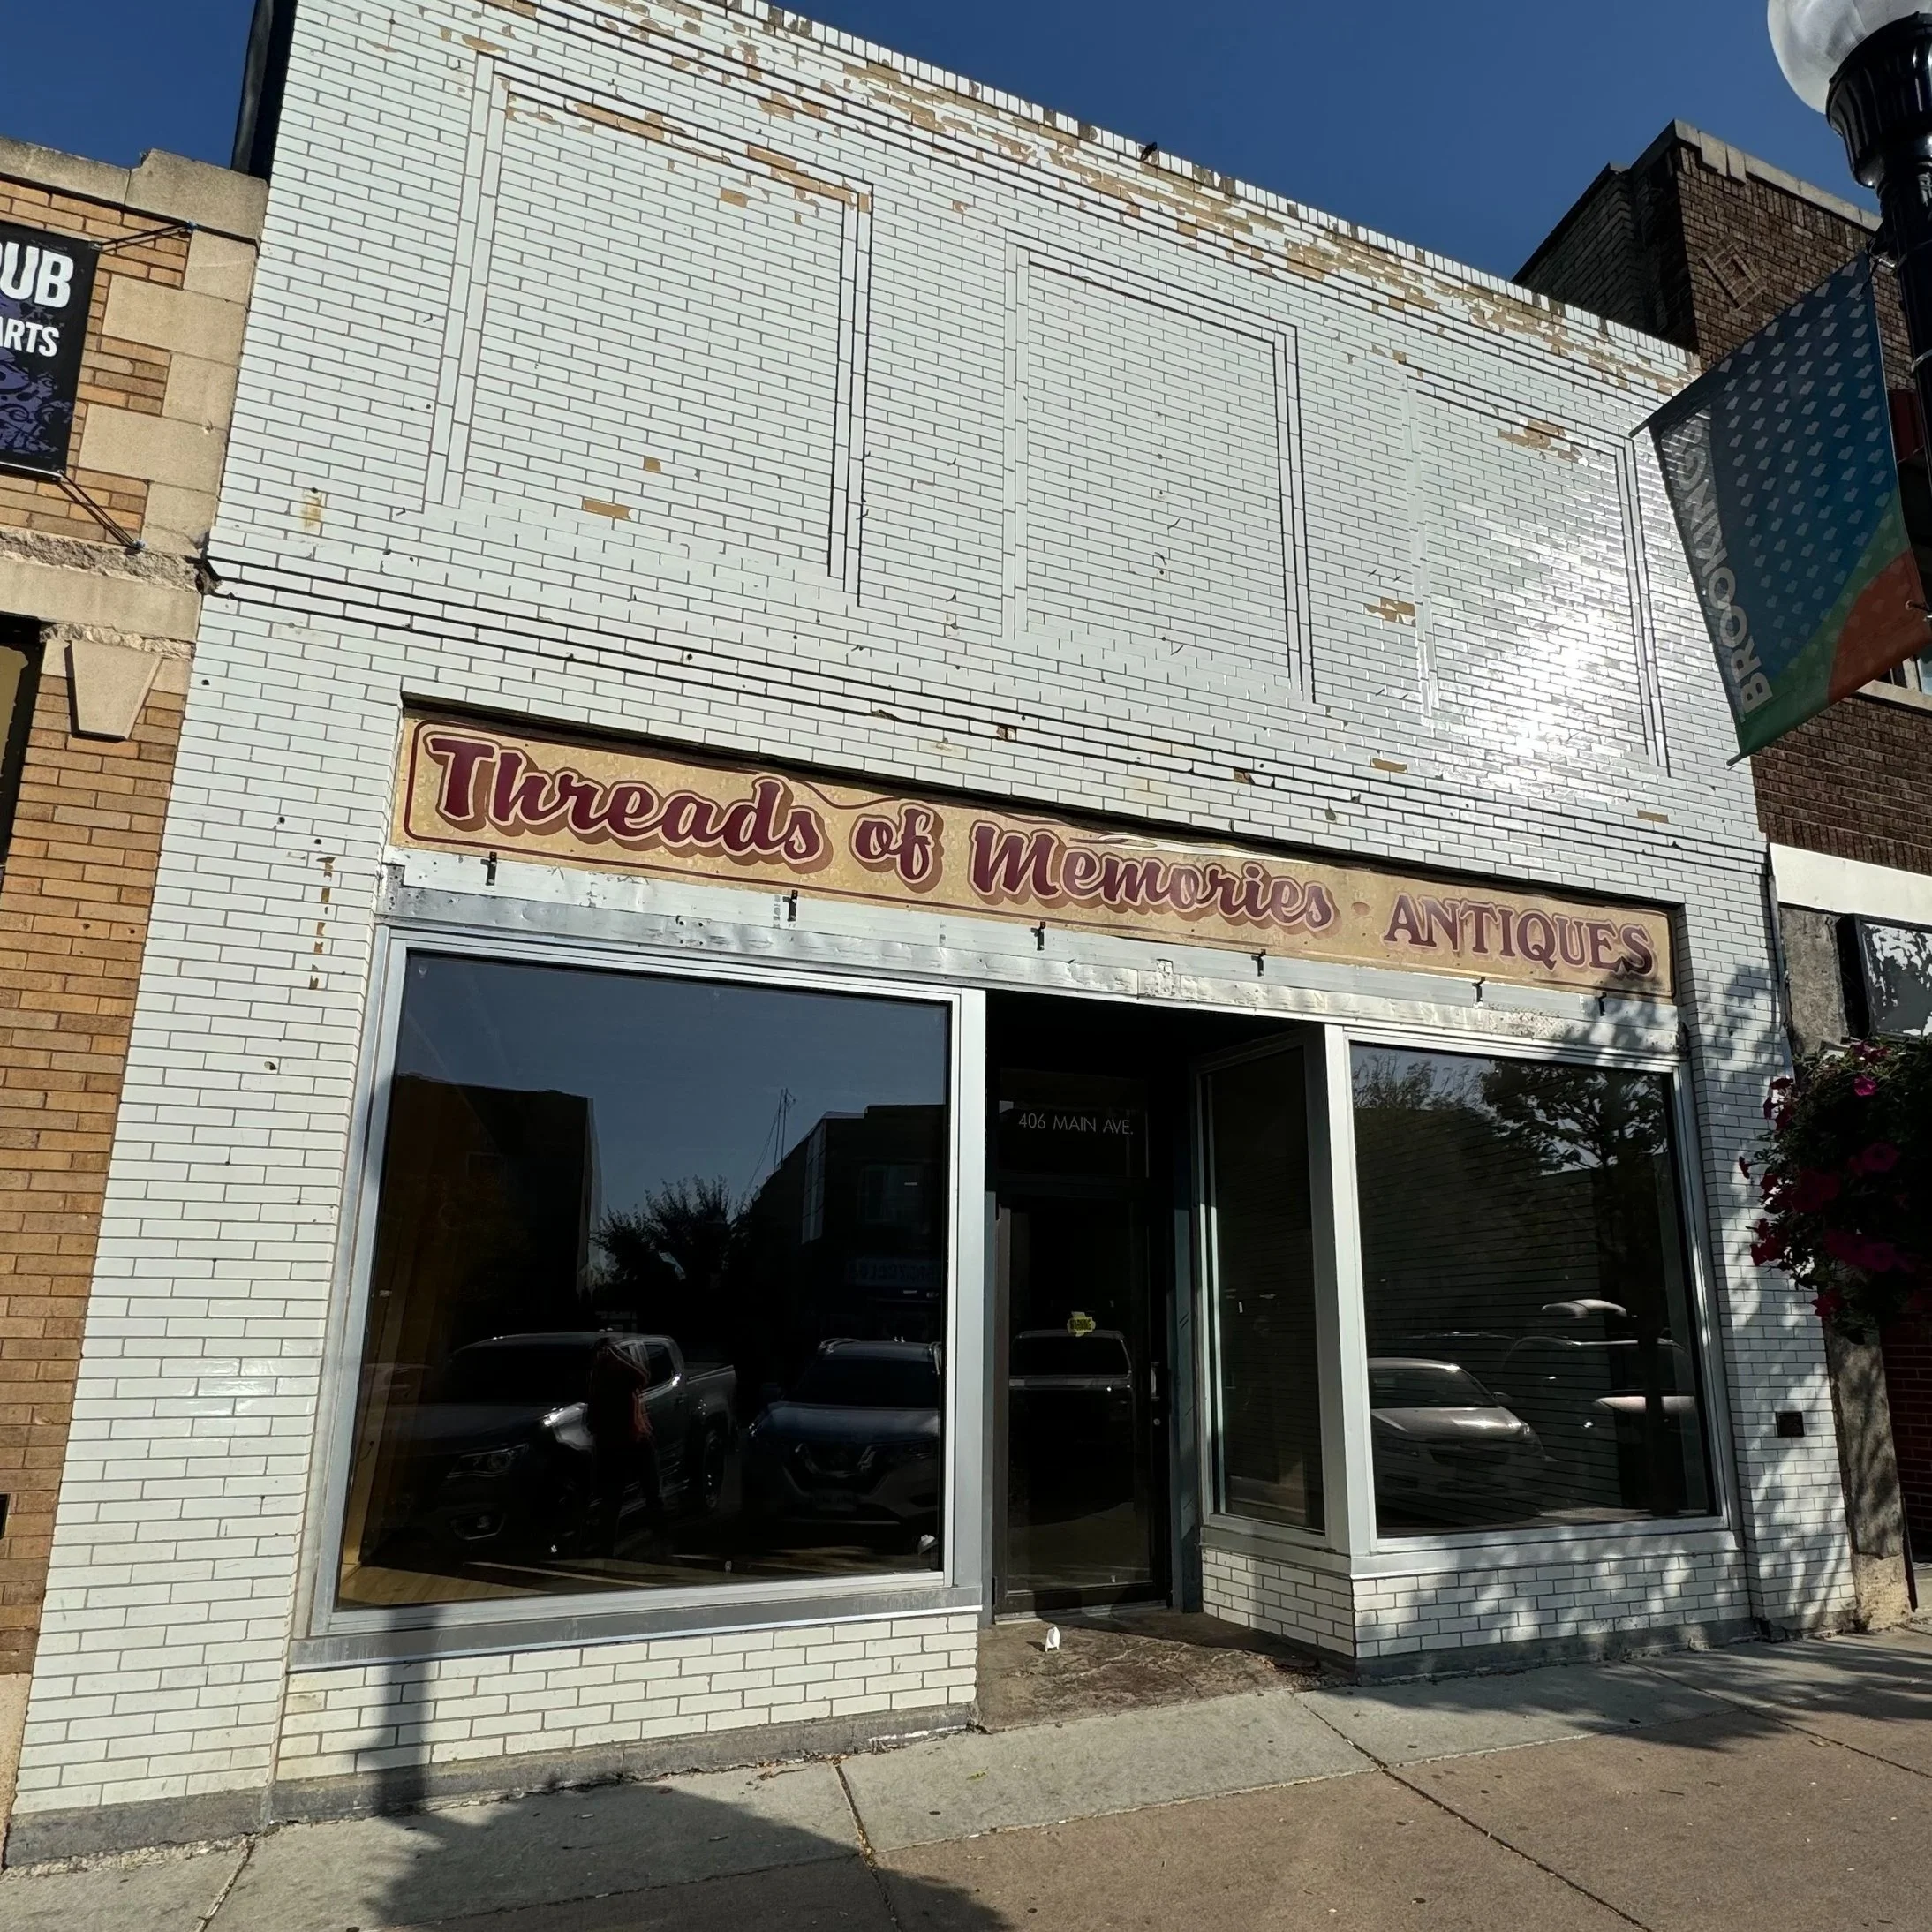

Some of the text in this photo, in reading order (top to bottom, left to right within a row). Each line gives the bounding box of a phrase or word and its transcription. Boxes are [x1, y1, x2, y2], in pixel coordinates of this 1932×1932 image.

[0, 242, 74, 308] UB
[1669, 417, 1773, 715] BROOKINGS
[425, 734, 1657, 977] Threads of Memories ANTIQUES
[1018, 1113, 1134, 1135] 406 MAIN AVE.
